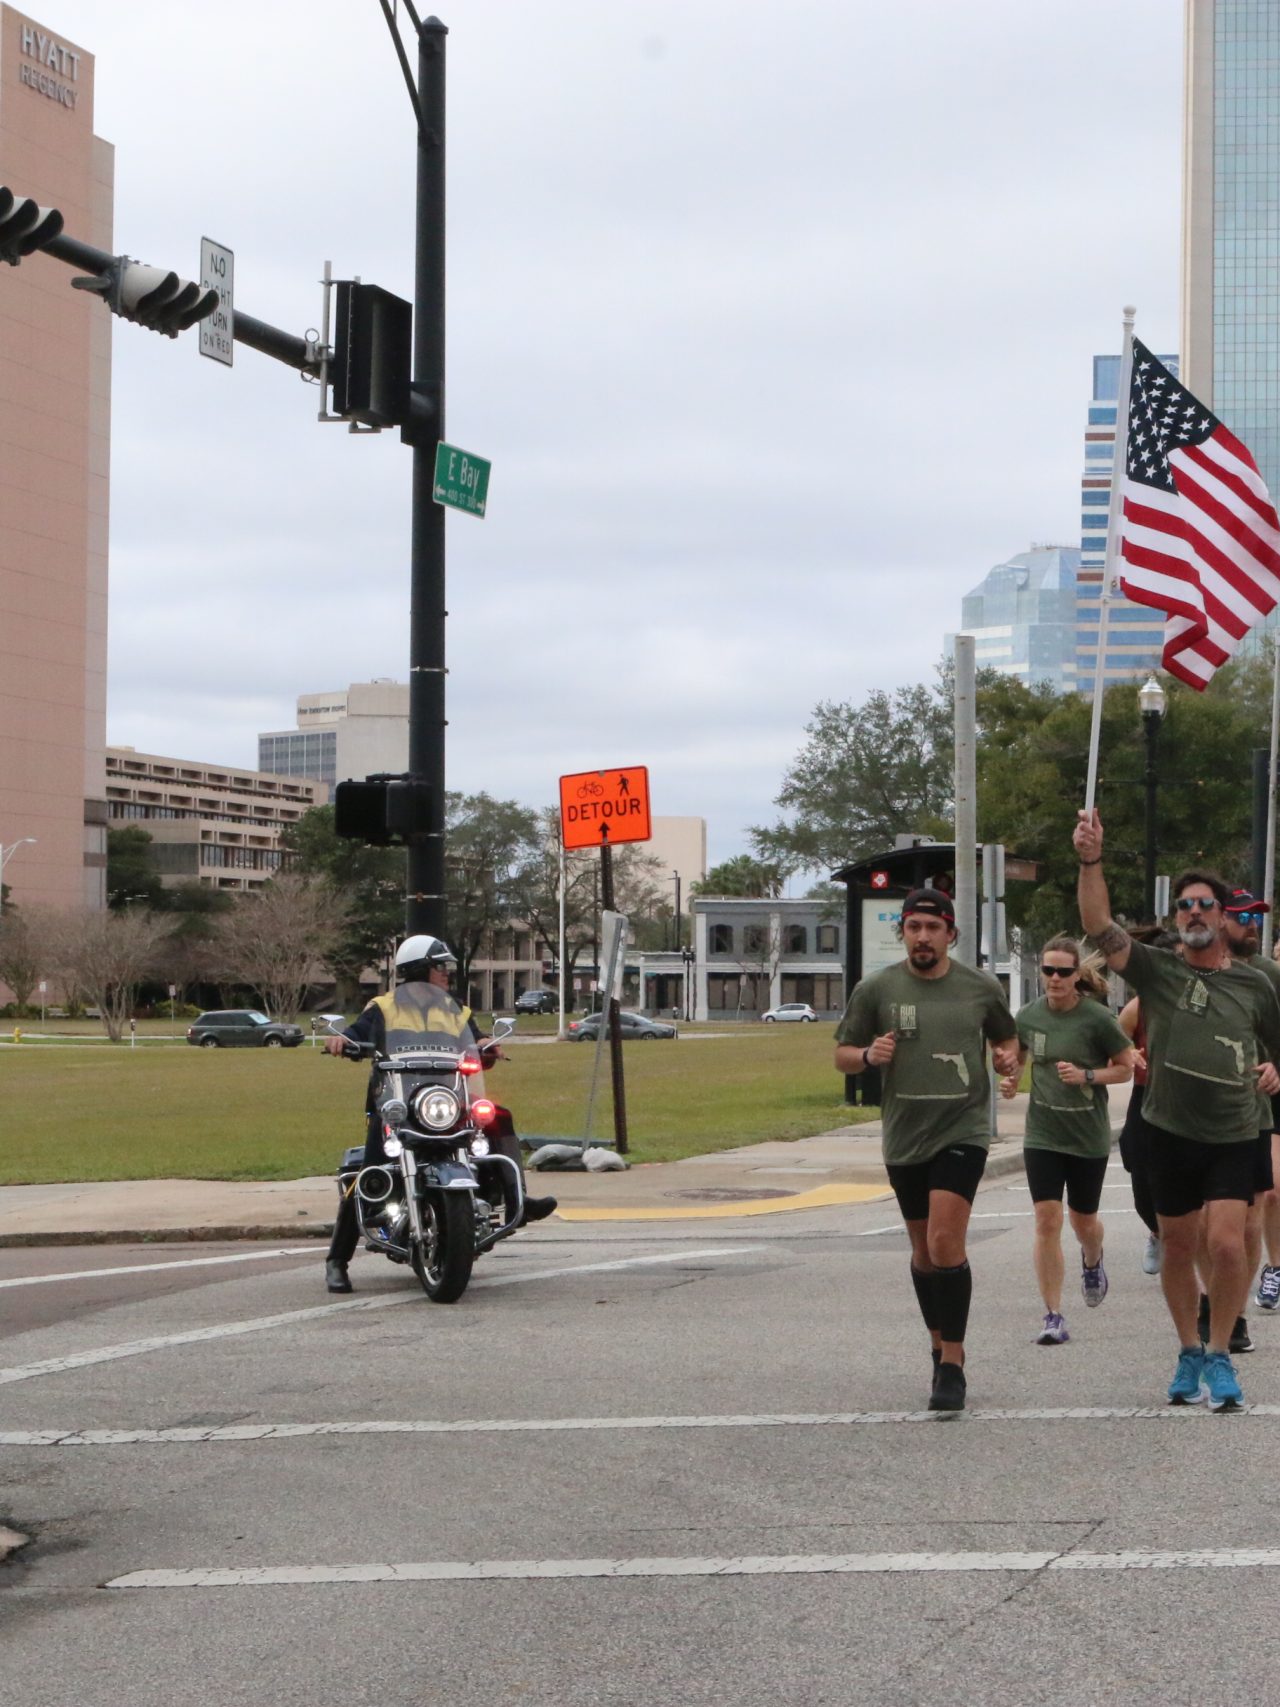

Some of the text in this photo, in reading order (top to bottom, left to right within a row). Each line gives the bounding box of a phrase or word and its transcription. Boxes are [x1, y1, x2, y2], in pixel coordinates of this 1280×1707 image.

[21, 23, 80, 81] HYATT
[20, 64, 78, 111] REGENCY
[210, 252, 226, 278] NO
[203, 332, 231, 355] ON RED
[447, 452, 480, 497] E Bay
[567, 798, 641, 822] DETOUR
